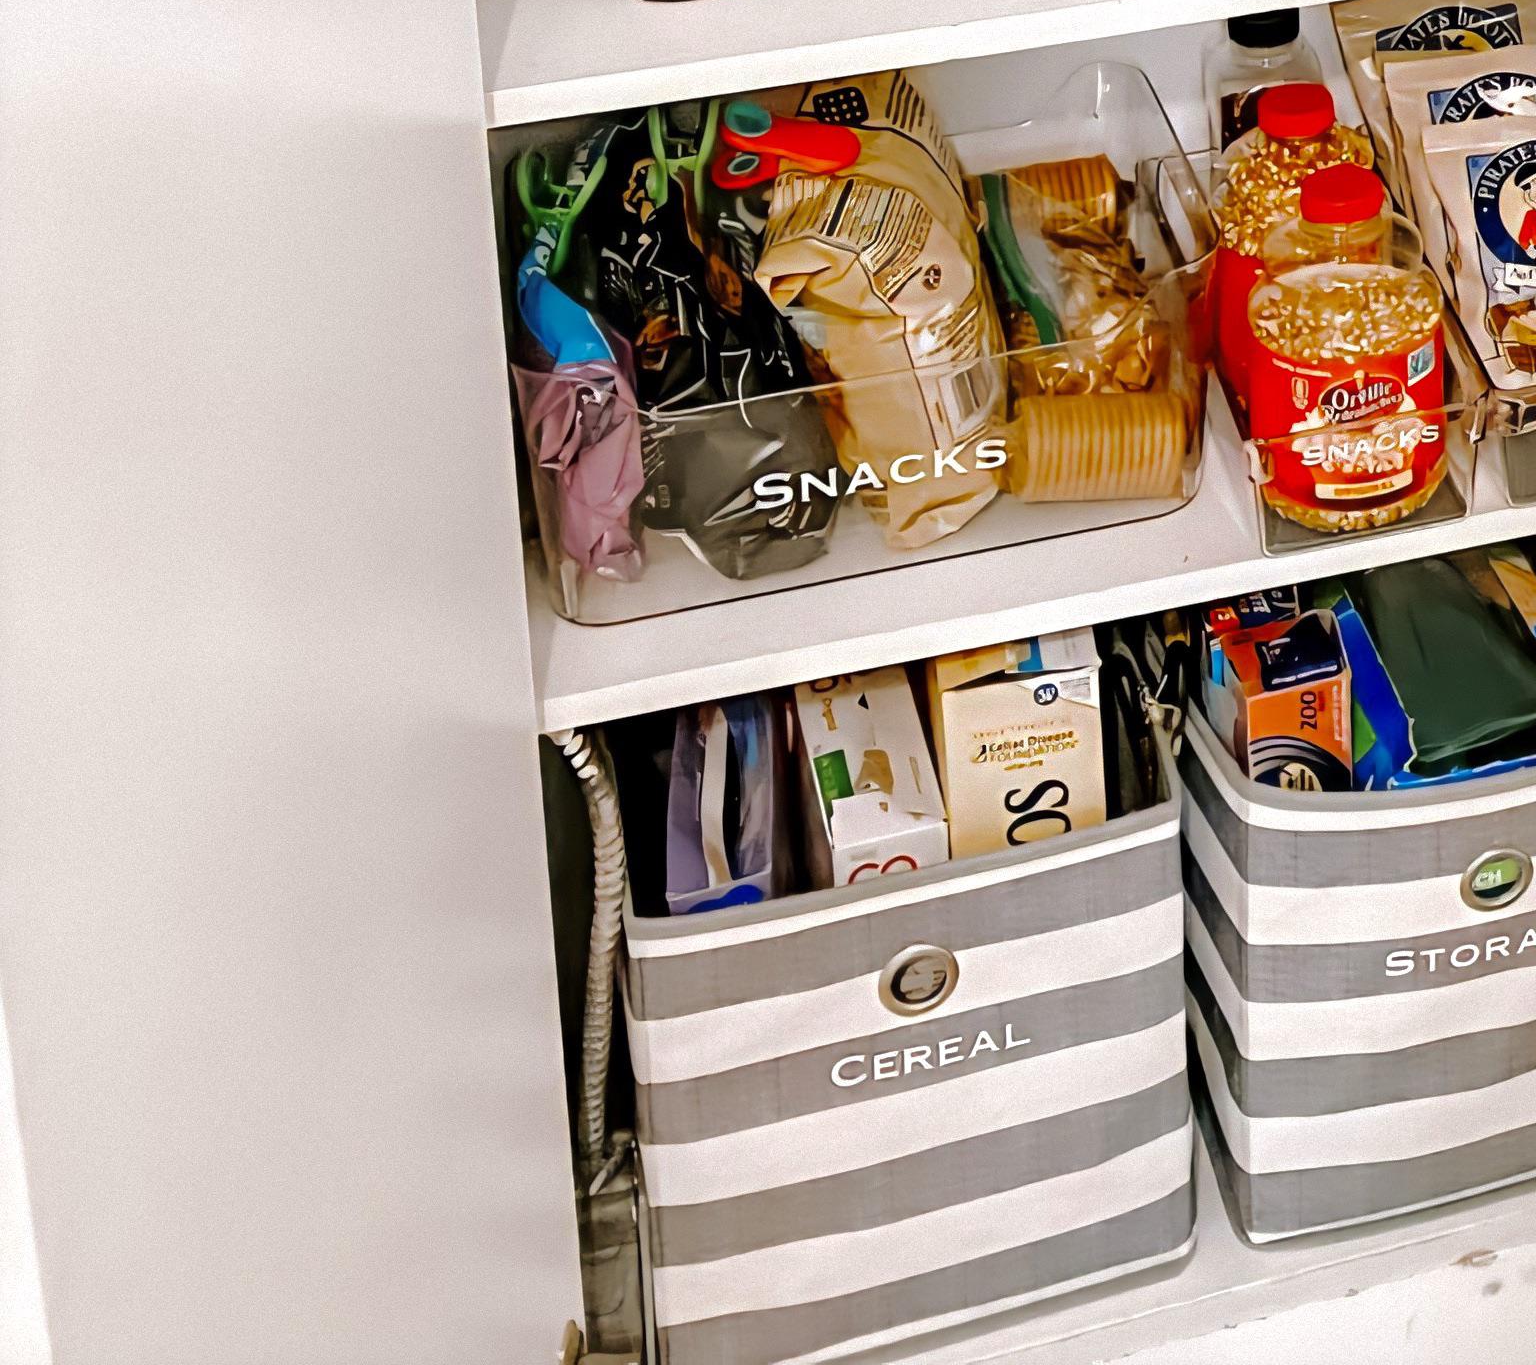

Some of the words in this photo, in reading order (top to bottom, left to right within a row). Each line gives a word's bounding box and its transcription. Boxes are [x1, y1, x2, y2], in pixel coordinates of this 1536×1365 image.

[1331, 379, 1393, 409] Orville
[1301, 425, 1440, 466] SNACKS
[751, 438, 1010, 511] SNACKS
[830, 1023, 1031, 1089] CEREAL
